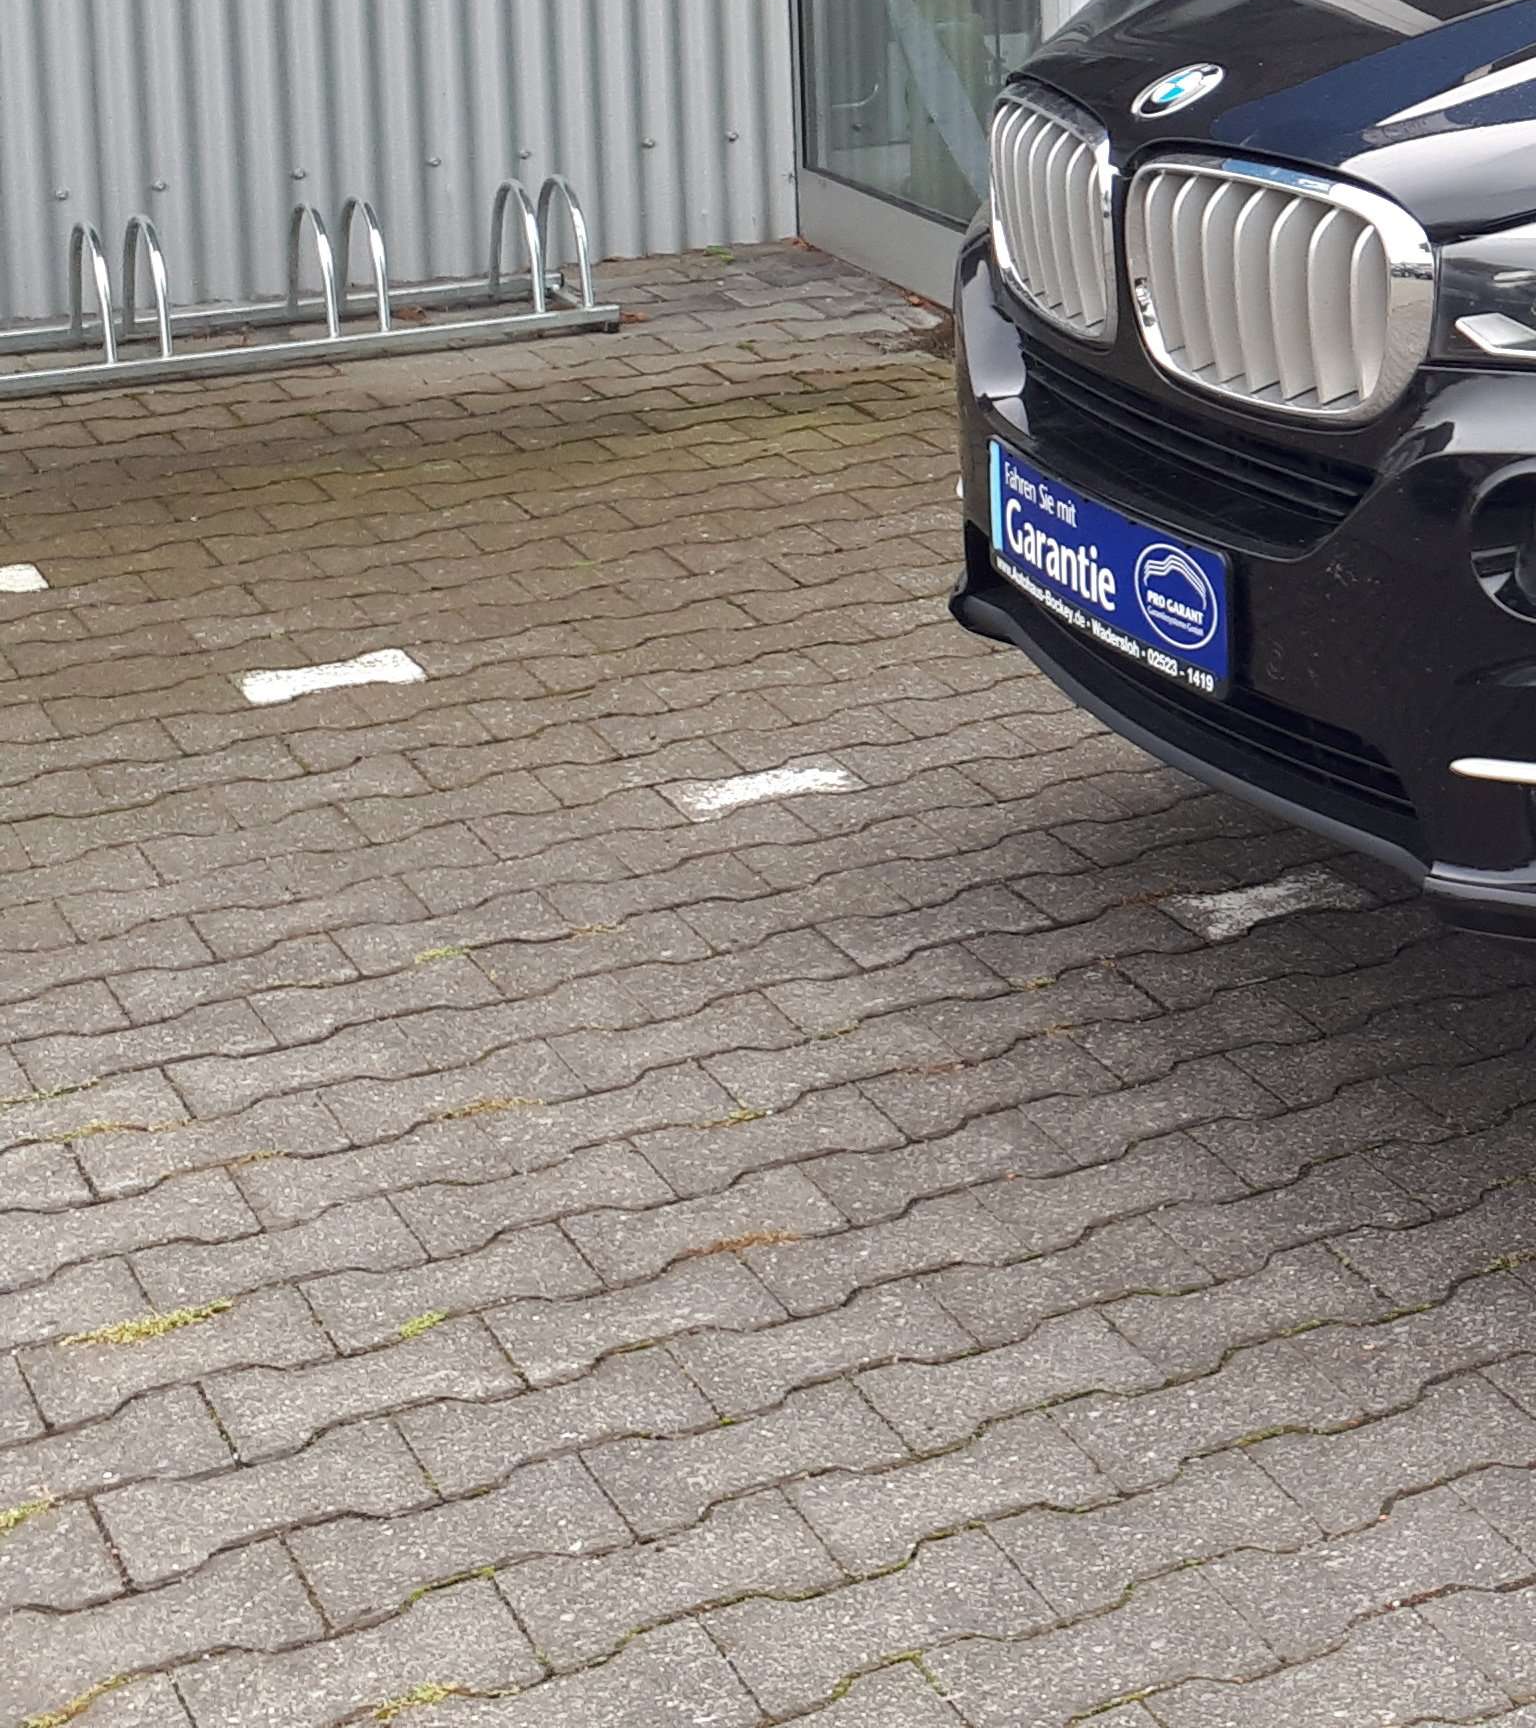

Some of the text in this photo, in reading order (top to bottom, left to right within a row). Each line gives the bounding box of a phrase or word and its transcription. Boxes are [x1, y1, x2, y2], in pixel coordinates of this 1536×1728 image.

[1004, 461, 1078, 528] Fahren Sie mit
[1006, 498, 1116, 611] Garantie
[1146, 589, 1166, 609] PRO
[1166, 598, 1205, 625] GARANT
[1091, 617, 1140, 659] Wadersloh
[1187, 667, 1214, 693] 1419
